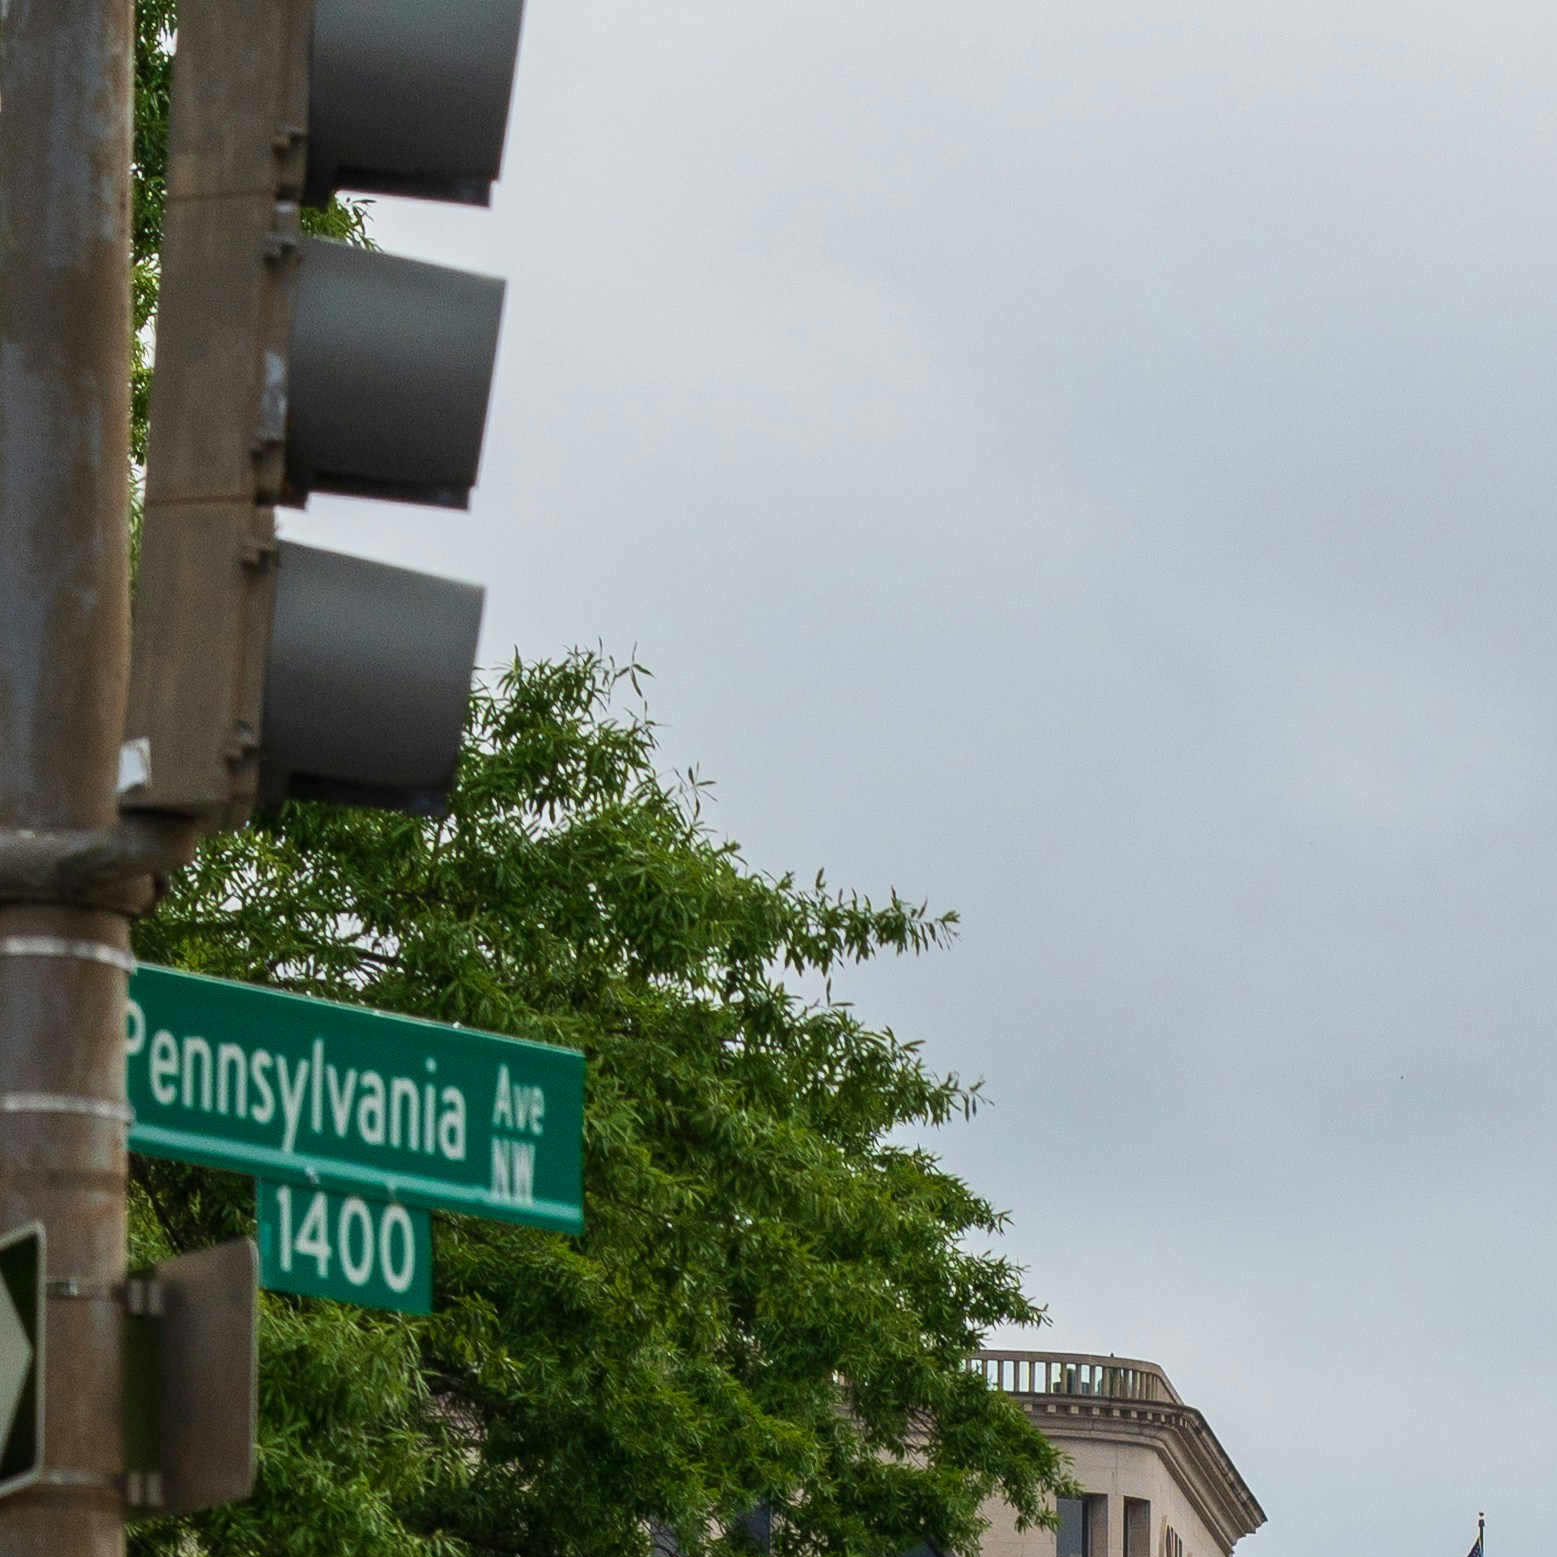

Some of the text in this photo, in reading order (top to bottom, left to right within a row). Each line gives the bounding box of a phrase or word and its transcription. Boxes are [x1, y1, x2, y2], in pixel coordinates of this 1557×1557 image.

[127, 1000, 467, 1161] Pennsylvania
[492, 1064, 545, 1136] Ave
[491, 1138, 535, 1205] NW
[276, 1184, 415, 1293] 1400
